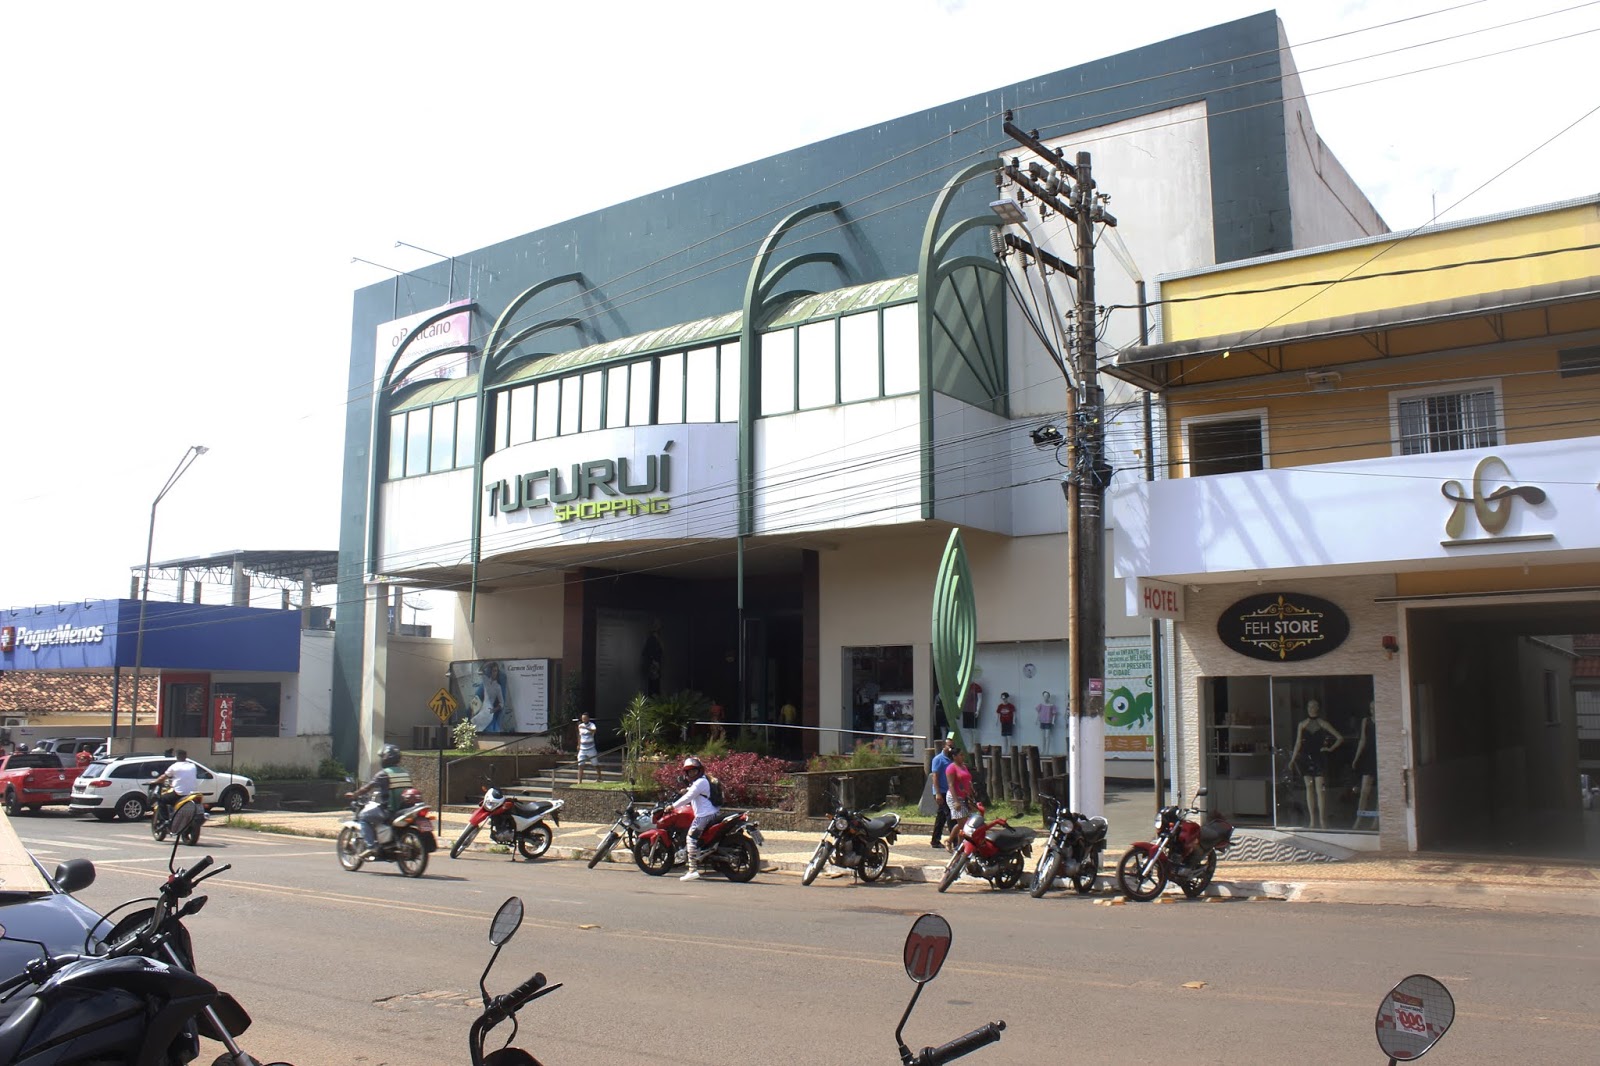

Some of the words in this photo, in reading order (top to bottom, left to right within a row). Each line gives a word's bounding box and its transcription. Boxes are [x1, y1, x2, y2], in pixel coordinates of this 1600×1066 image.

[485, 440, 674, 517] TUCURUÍ
[554, 497, 670, 522] SHOPPING
[1144, 587, 1178, 612] HOTEL
[15, 623, 104, 651] PagueMenos
[1245, 622, 1270, 635] FEH
[1274, 620, 1319, 634] STORE
[143, 966, 170, 974] HONDA
